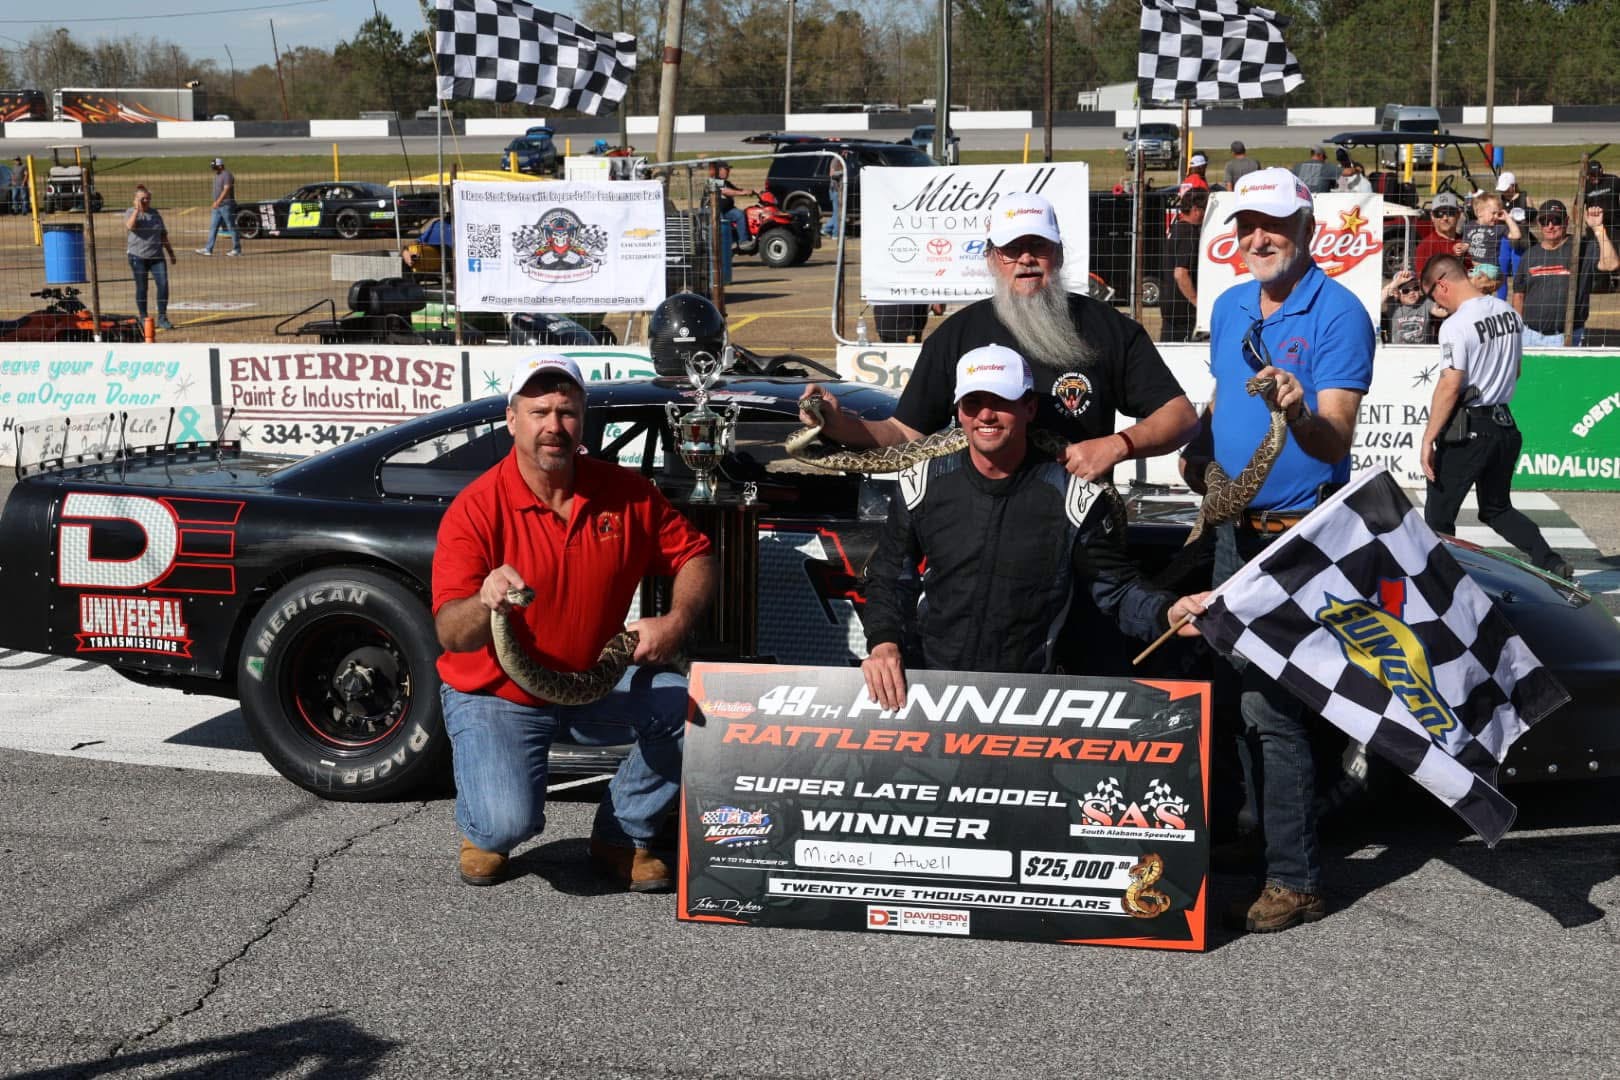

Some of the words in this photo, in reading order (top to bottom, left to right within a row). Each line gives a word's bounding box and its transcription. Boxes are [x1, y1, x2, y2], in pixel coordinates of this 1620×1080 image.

[892, 168, 1056, 212] Mitchll
[890, 287, 995, 296] MITCHELLAU
[1473, 311, 1522, 344] POLICE
[0, 358, 40, 376] eave
[50, 359, 93, 379] your
[103, 351, 180, 379] Legacy
[229, 352, 456, 391] ENTERPRISE
[106, 383, 161, 406] Donor
[232, 383, 276, 407] Paint
[281, 385, 297, 408] &
[303, 385, 406, 413] Industrial,
[413, 388, 447, 409] Inc.
[1357, 404, 1394, 425] ENT
[1401, 405, 1430, 425] BA
[1572, 392, 1620, 438] BOBBY
[261, 424, 388, 445] 334-347-
[1352, 432, 1413, 449] LUSIA
[1516, 453, 1620, 479] ANDALUSI
[81, 596, 185, 637] UNIVERSAL
[90, 637, 177, 652] TRANSMISSIONS
[246, 588, 369, 682] AMERICAN
[1325, 605, 1448, 728] SUNOCO
[847, 684, 1141, 729] ANNUAL
[342, 723, 430, 784] RACER
[722, 723, 930, 753] RATTLER
[943, 733, 1184, 764] WEEKEND
[734, 776, 846, 797] SUPER
[854, 782, 940, 801] LATE
[948, 787, 1068, 808] MODEL
[801, 809, 990, 840] WINNER
[1082, 799, 1187, 830] SAS
[704, 824, 773, 837] National
[1144, 832, 1186, 840] Speedway
[803, 847, 872, 866] Michael
[893, 852, 951, 869] Atwell
[781, 882, 858, 896] TWENTY
[863, 887, 912, 898] FIVE
[918, 890, 1016, 904] THOUSAND
[1021, 896, 1111, 909] DOLLARS
[904, 911, 968, 922] DAVIDSON
[904, 919, 968, 928] ELECTRIC
